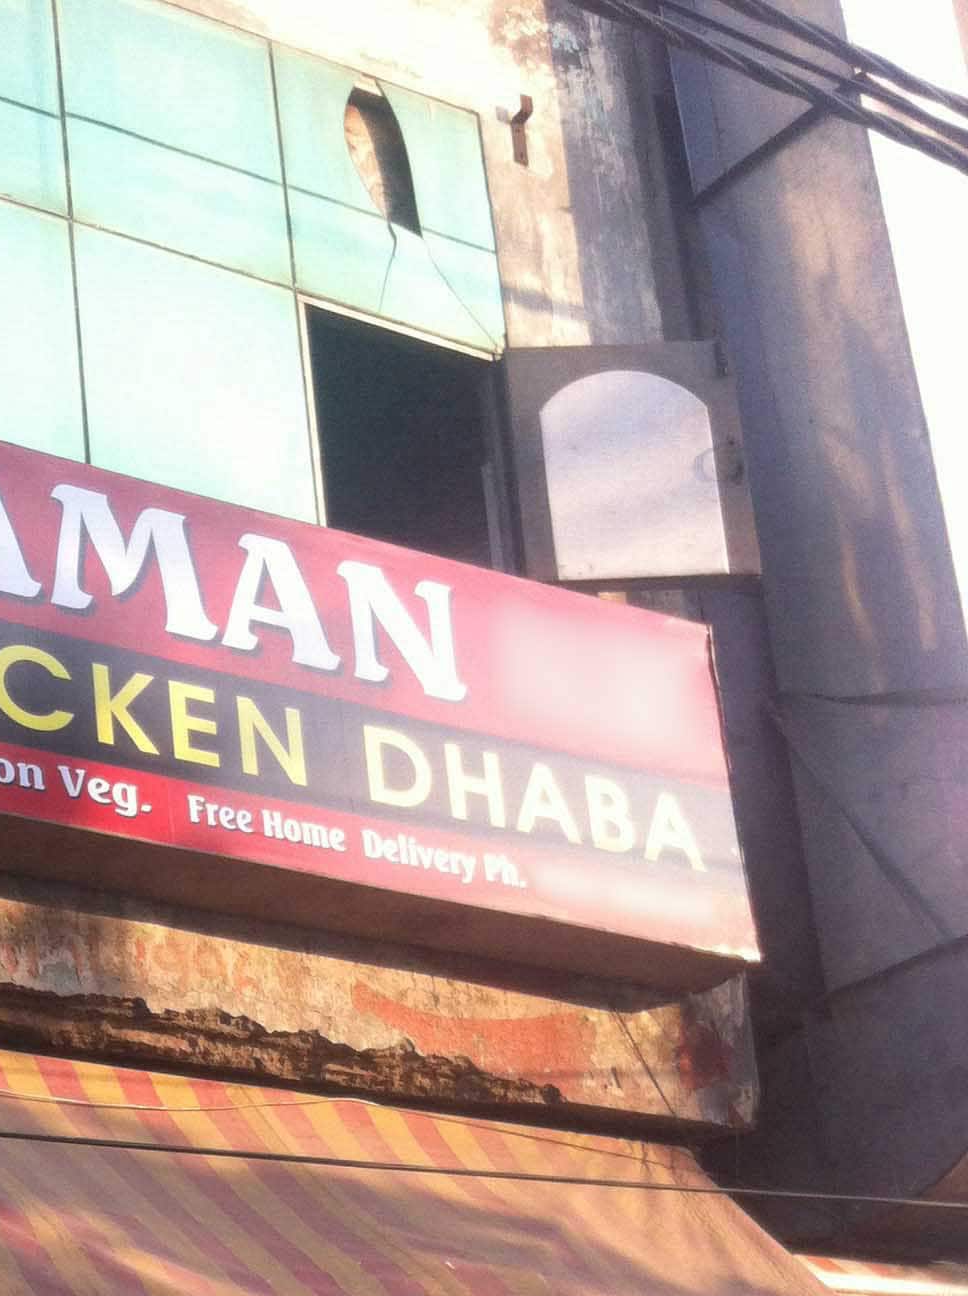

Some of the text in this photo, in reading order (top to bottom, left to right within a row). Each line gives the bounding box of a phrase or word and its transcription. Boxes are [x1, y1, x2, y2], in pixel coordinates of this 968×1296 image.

[58, 765, 153, 817] Veg.
[187, 794, 253, 834] Free
[261, 808, 347, 853] Home
[362, 828, 476, 885] Delivery
[482, 852, 528, 888] Ph.
[363, 724, 708, 872] DHABA
